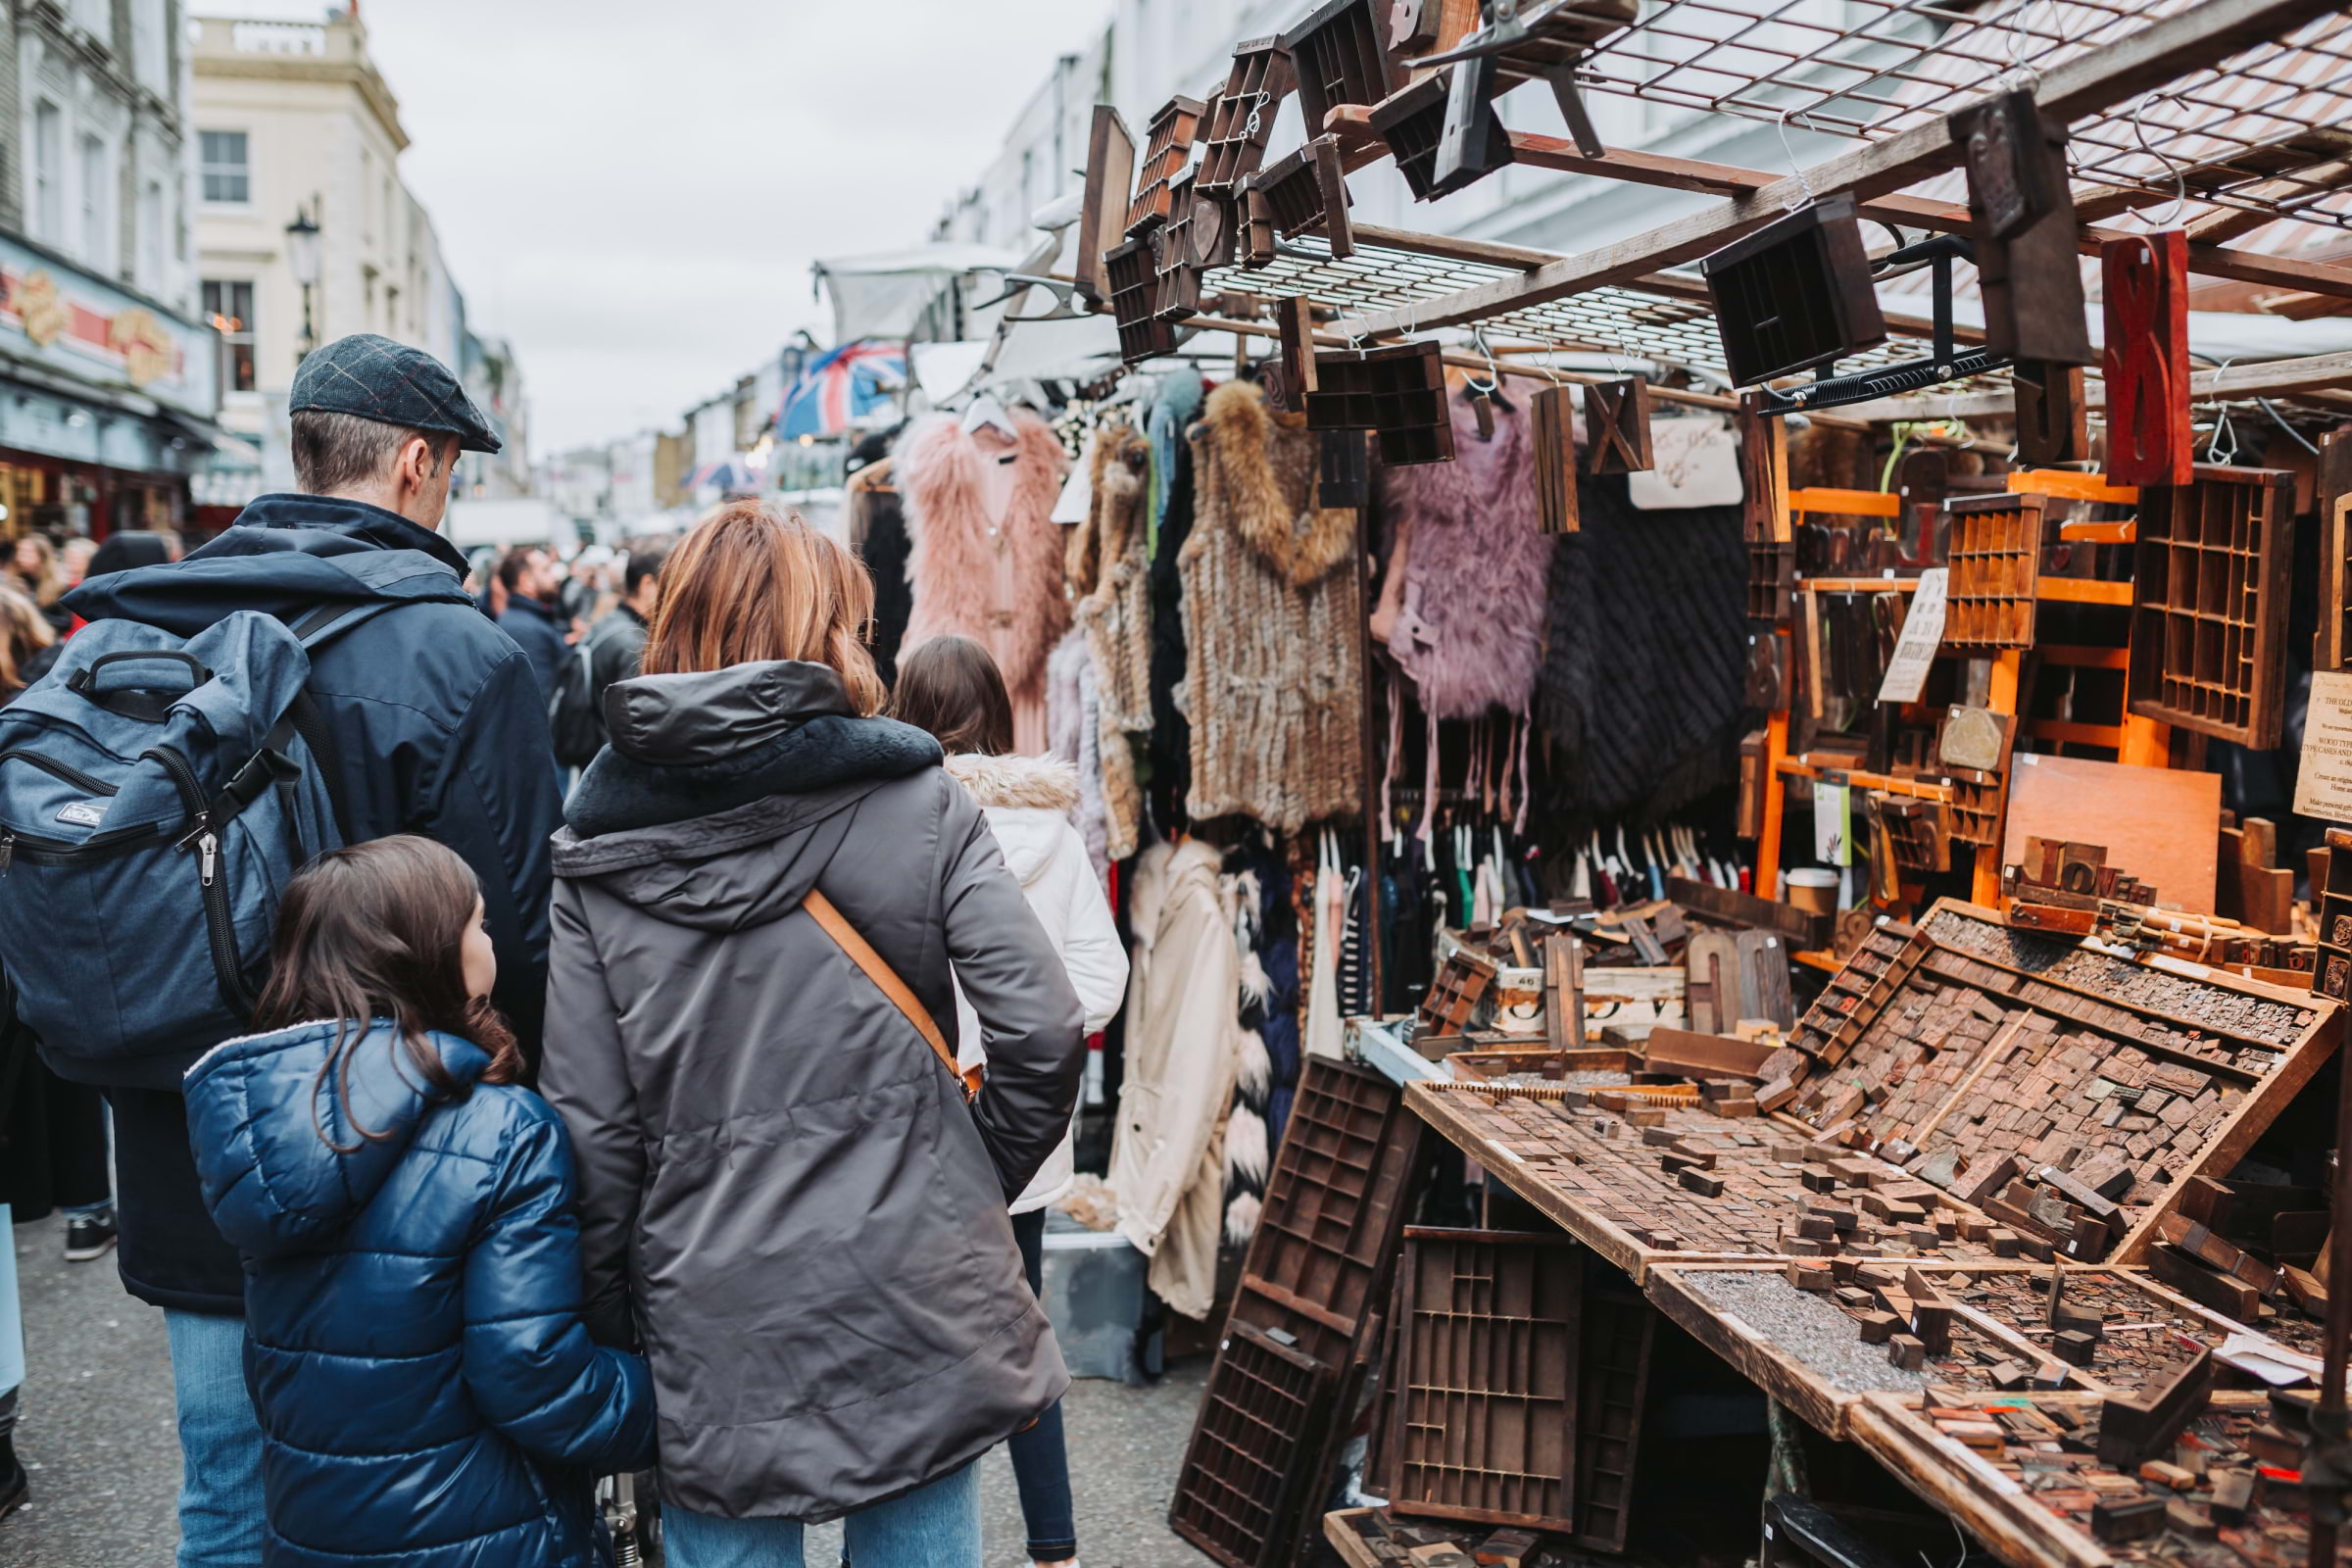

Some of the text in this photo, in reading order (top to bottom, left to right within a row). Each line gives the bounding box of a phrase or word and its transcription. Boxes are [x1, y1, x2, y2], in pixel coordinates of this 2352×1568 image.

[2326, 697, 2338, 706] THE
[2319, 737, 2338, 747] WOOD
[2303, 744, 2319, 753] TYPE
[2319, 746, 2337, 755] CASES
